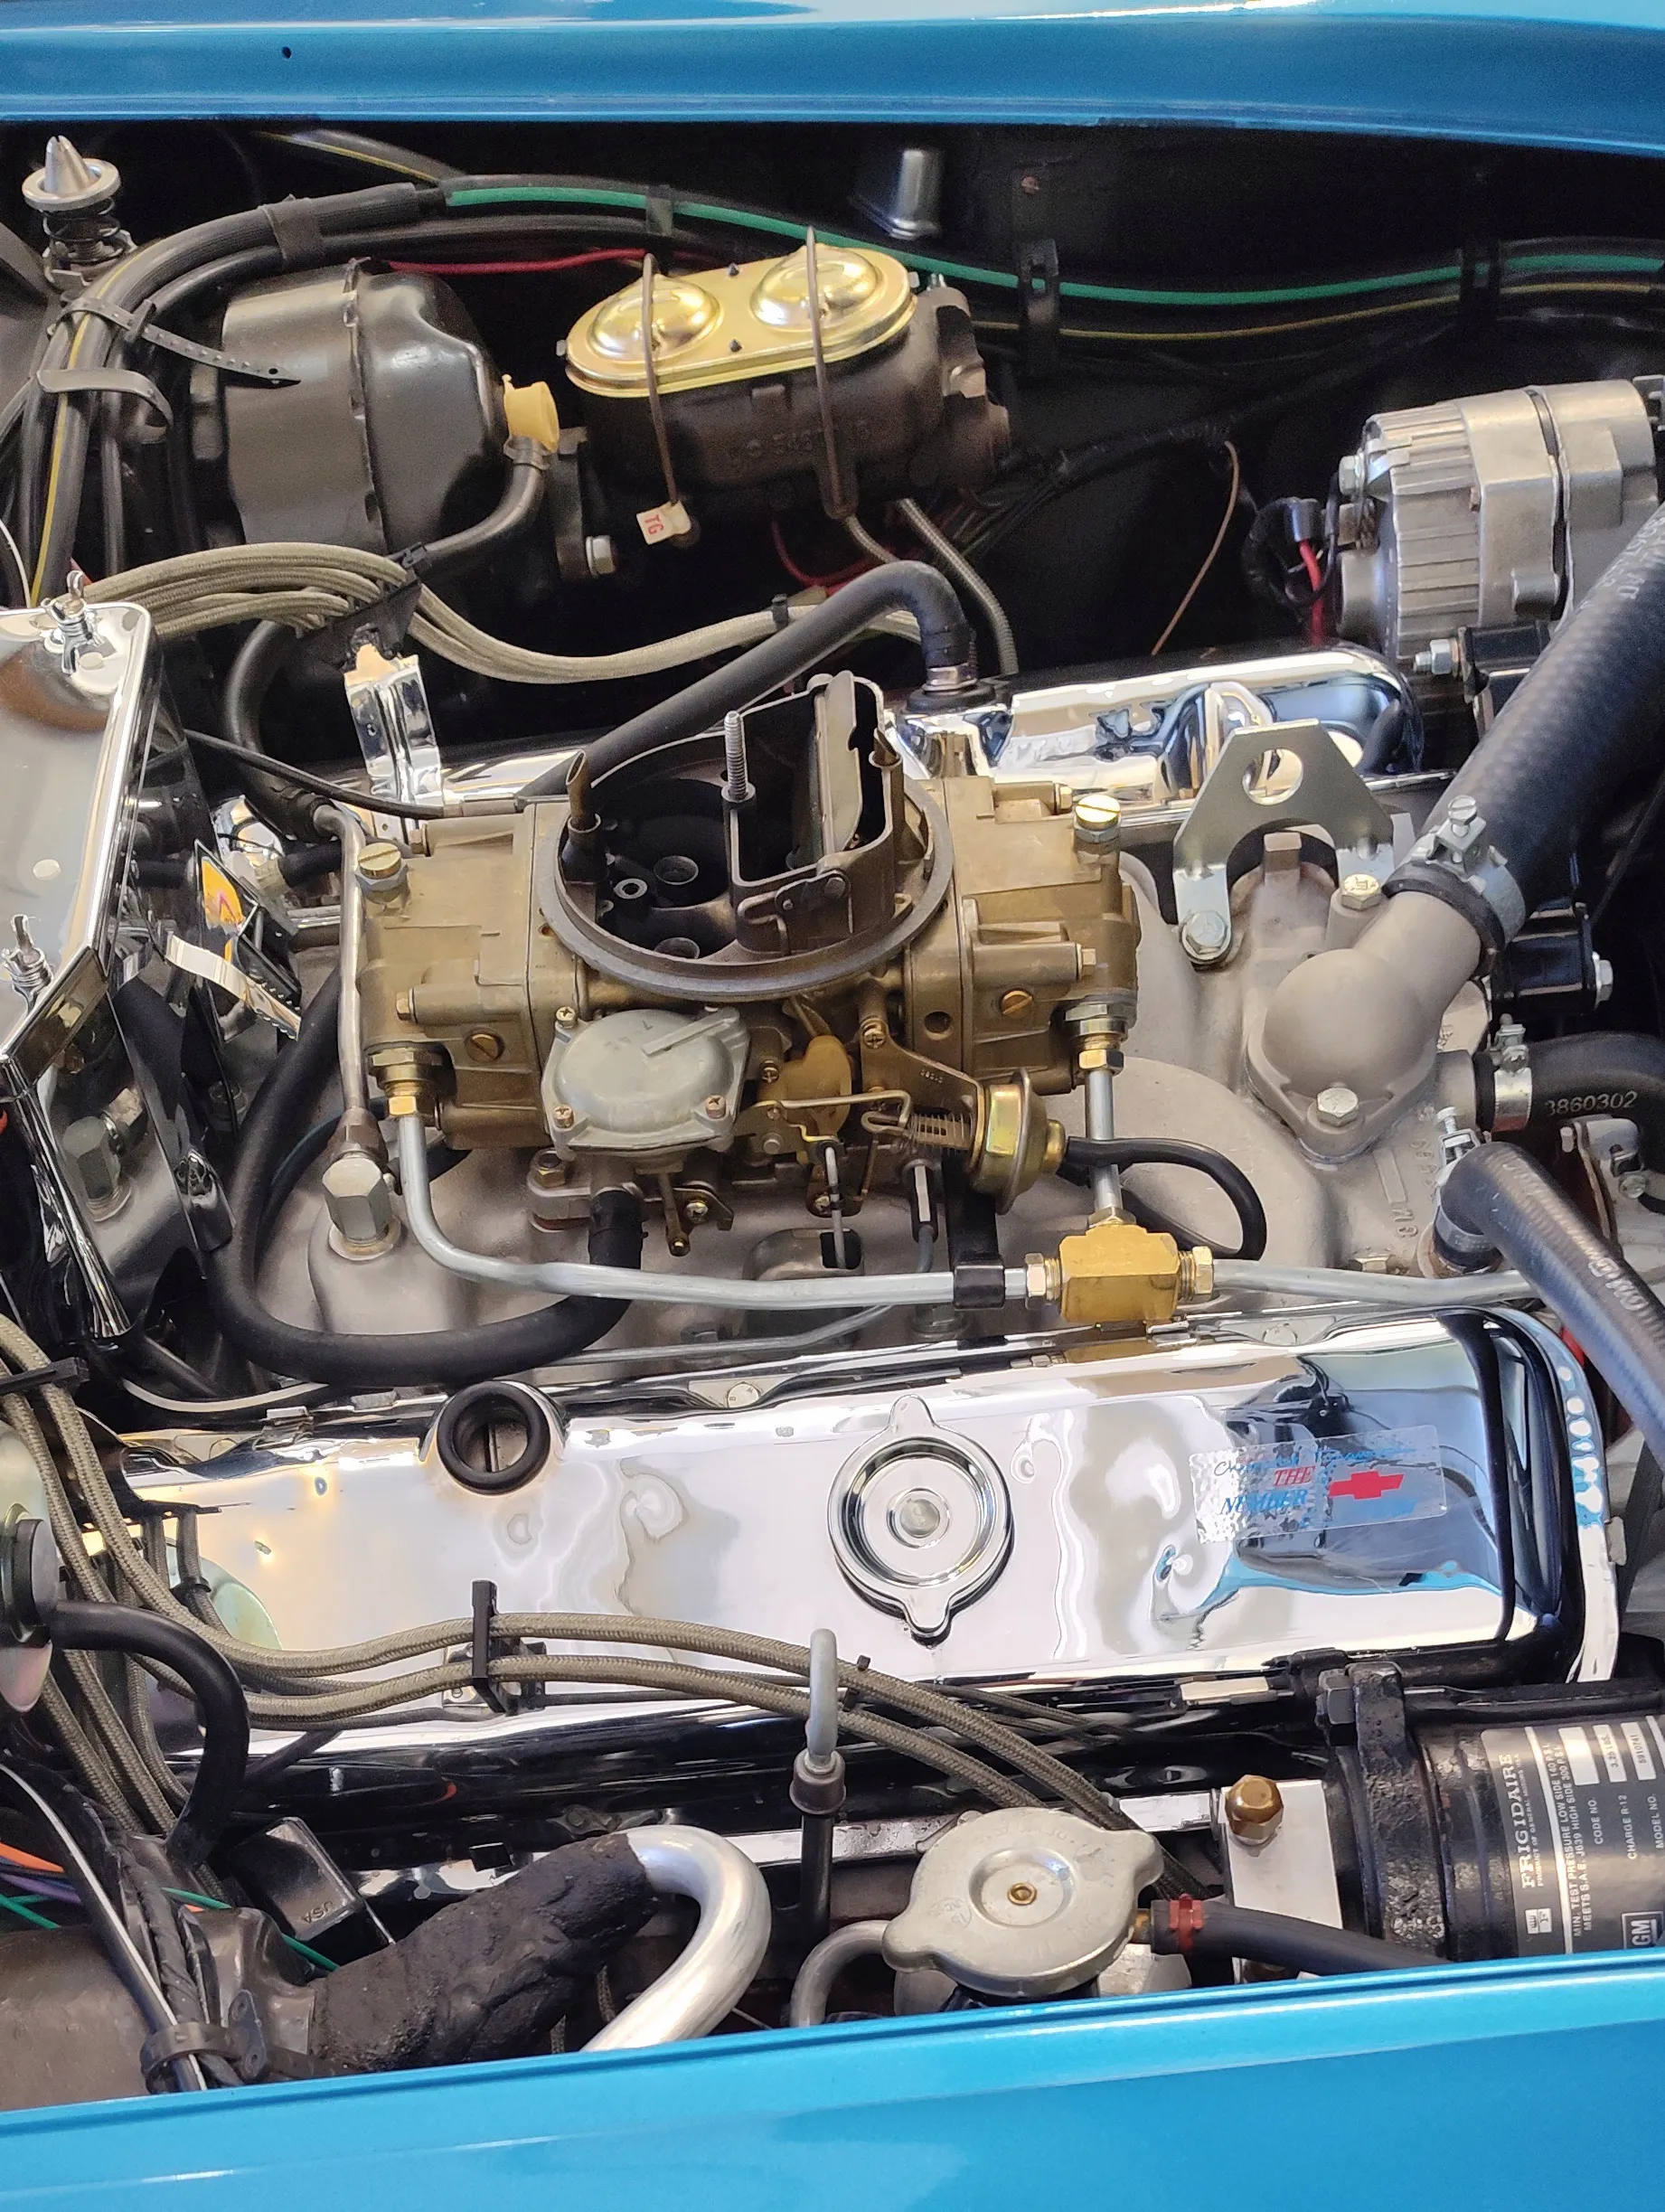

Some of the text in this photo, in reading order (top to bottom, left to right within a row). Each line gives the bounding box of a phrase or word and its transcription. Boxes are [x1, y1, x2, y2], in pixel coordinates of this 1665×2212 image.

[644, 513, 664, 535] TG
[1272, 1464, 1317, 1487] THE
[1547, 1762, 1558, 1777] 140
[1558, 1765, 1570, 1781] 300
[1551, 1779, 1565, 1801] SIDE
[1562, 1783, 1576, 1804] SIDE
[1498, 1753, 1536, 1888] FRIGIDAIRE
[1556, 1802, 1569, 1823] LOW
[1568, 1805, 1580, 1831] HIGH
[1590, 1816, 1604, 1845] CODE
[1617, 1794, 1638, 1859] CHARGE R-12
[1651, 1812, 1665, 1849] MODEL
[1560, 1826, 1577, 1880] PRESSURE
[1568, 1883, 1581, 1909] TEST
[300, 1900, 334, 1925] USA
[1572, 1911, 1582, 1936] MIN.
[1580, 1893, 1592, 1931] MEETS
[1632, 1919, 1652, 1946] GM
